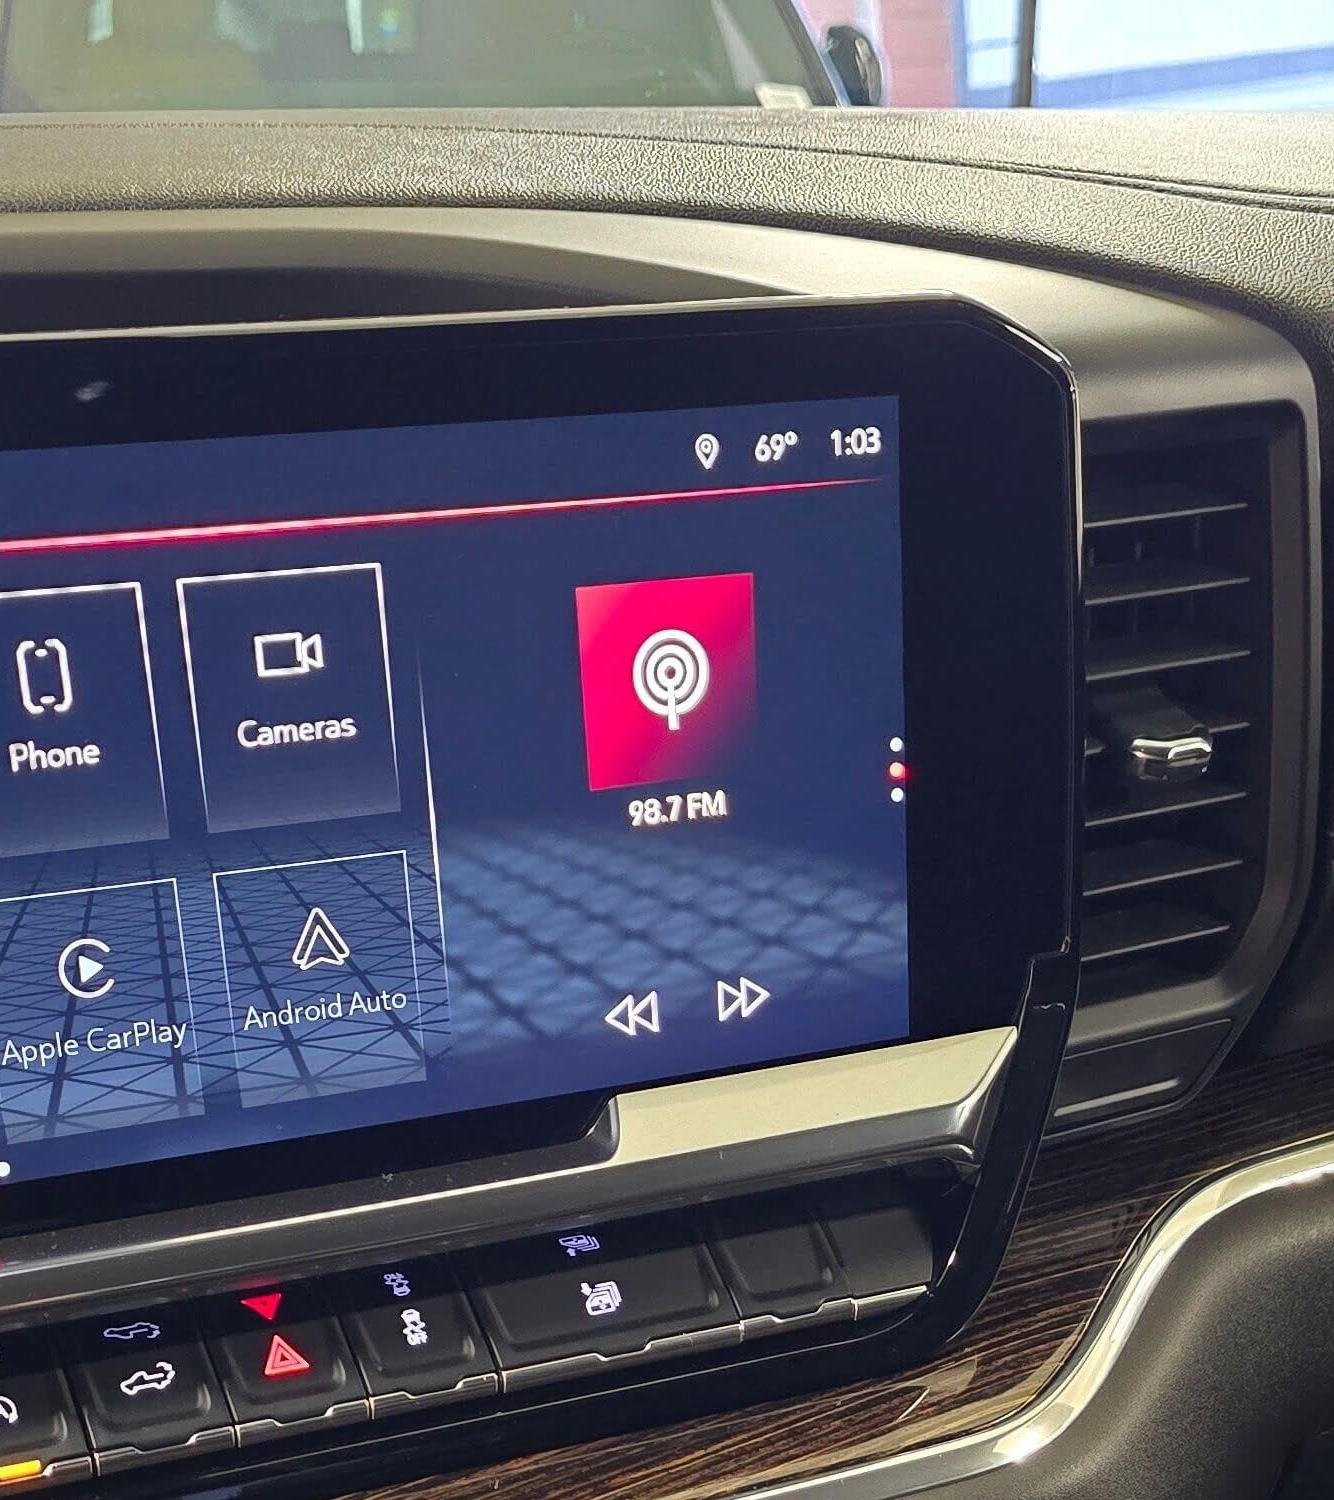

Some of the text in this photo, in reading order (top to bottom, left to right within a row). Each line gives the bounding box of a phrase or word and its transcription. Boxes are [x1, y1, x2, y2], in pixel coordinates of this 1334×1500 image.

[831, 427, 881, 456] 1:03
[238, 718, 356, 747] Cameras
[9, 741, 100, 772] Phone
[628, 790, 728, 827] 98.7 FM
[243, 990, 407, 1031] Android Auto
[1, 1015, 188, 1070] Apple CarPlay
